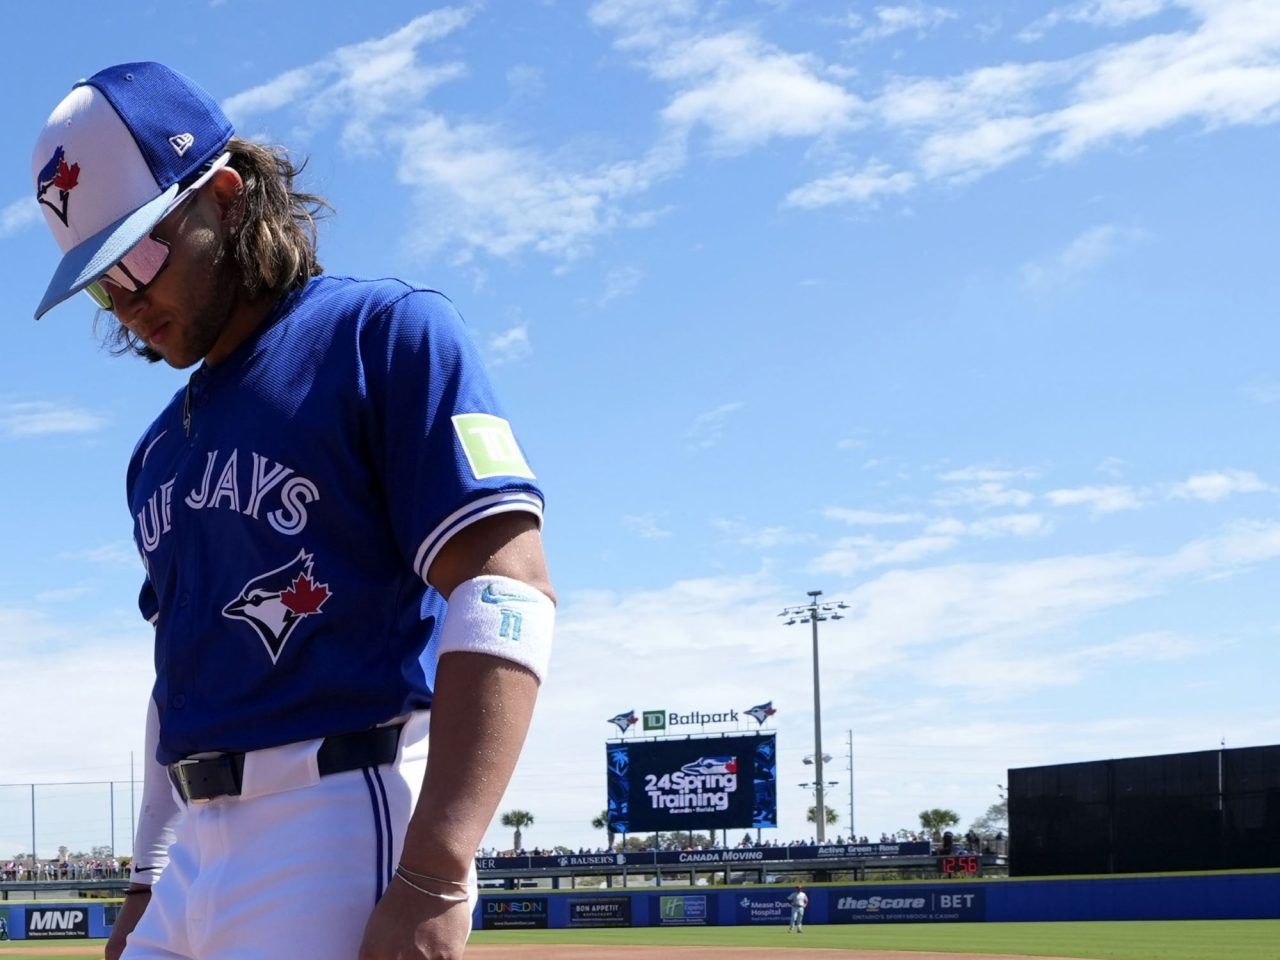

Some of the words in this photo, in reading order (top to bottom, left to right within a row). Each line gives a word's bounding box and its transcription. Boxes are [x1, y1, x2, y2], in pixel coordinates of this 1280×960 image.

[184, 448, 320, 536] JAYS
[644, 713, 664, 728] TD
[669, 709, 739, 727] Ballpark
[648, 789, 729, 811] Training
[679, 853, 719, 862] CANADA
[721, 851, 763, 860] MOVING
[818, 846, 845, 854] Active
[847, 845, 872, 853] Green
[837, 895, 926, 910] theScore
[940, 894, 975, 908] BET
[29, 910, 83, 930] MNP
[751, 908, 782, 917] Hospital
